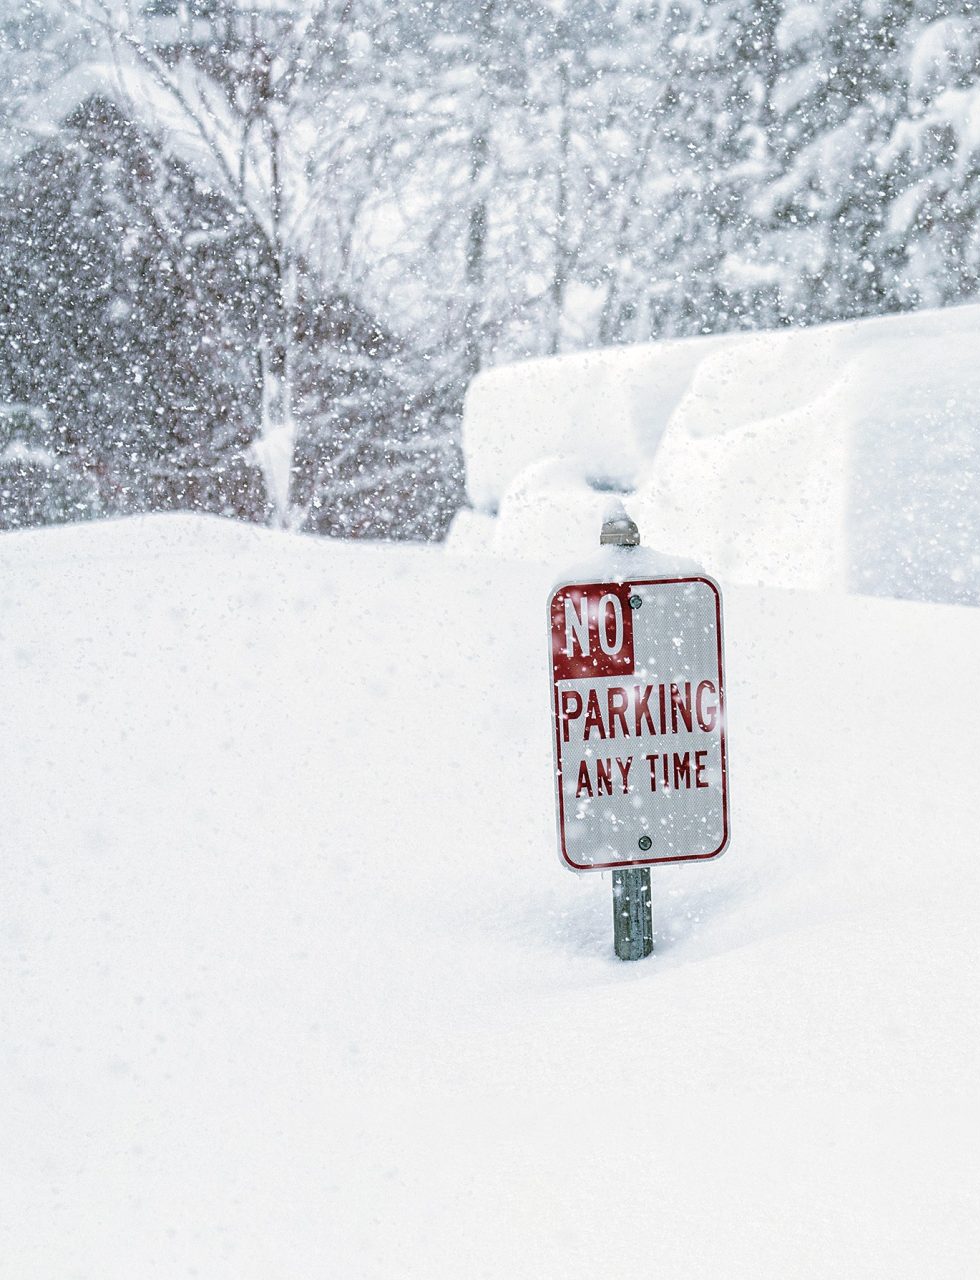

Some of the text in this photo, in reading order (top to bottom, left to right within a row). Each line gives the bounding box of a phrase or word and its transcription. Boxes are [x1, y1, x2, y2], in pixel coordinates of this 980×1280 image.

[563, 593, 624, 658] NO
[561, 680, 717, 742] PARKING
[575, 750, 709, 799] ANY TIME
